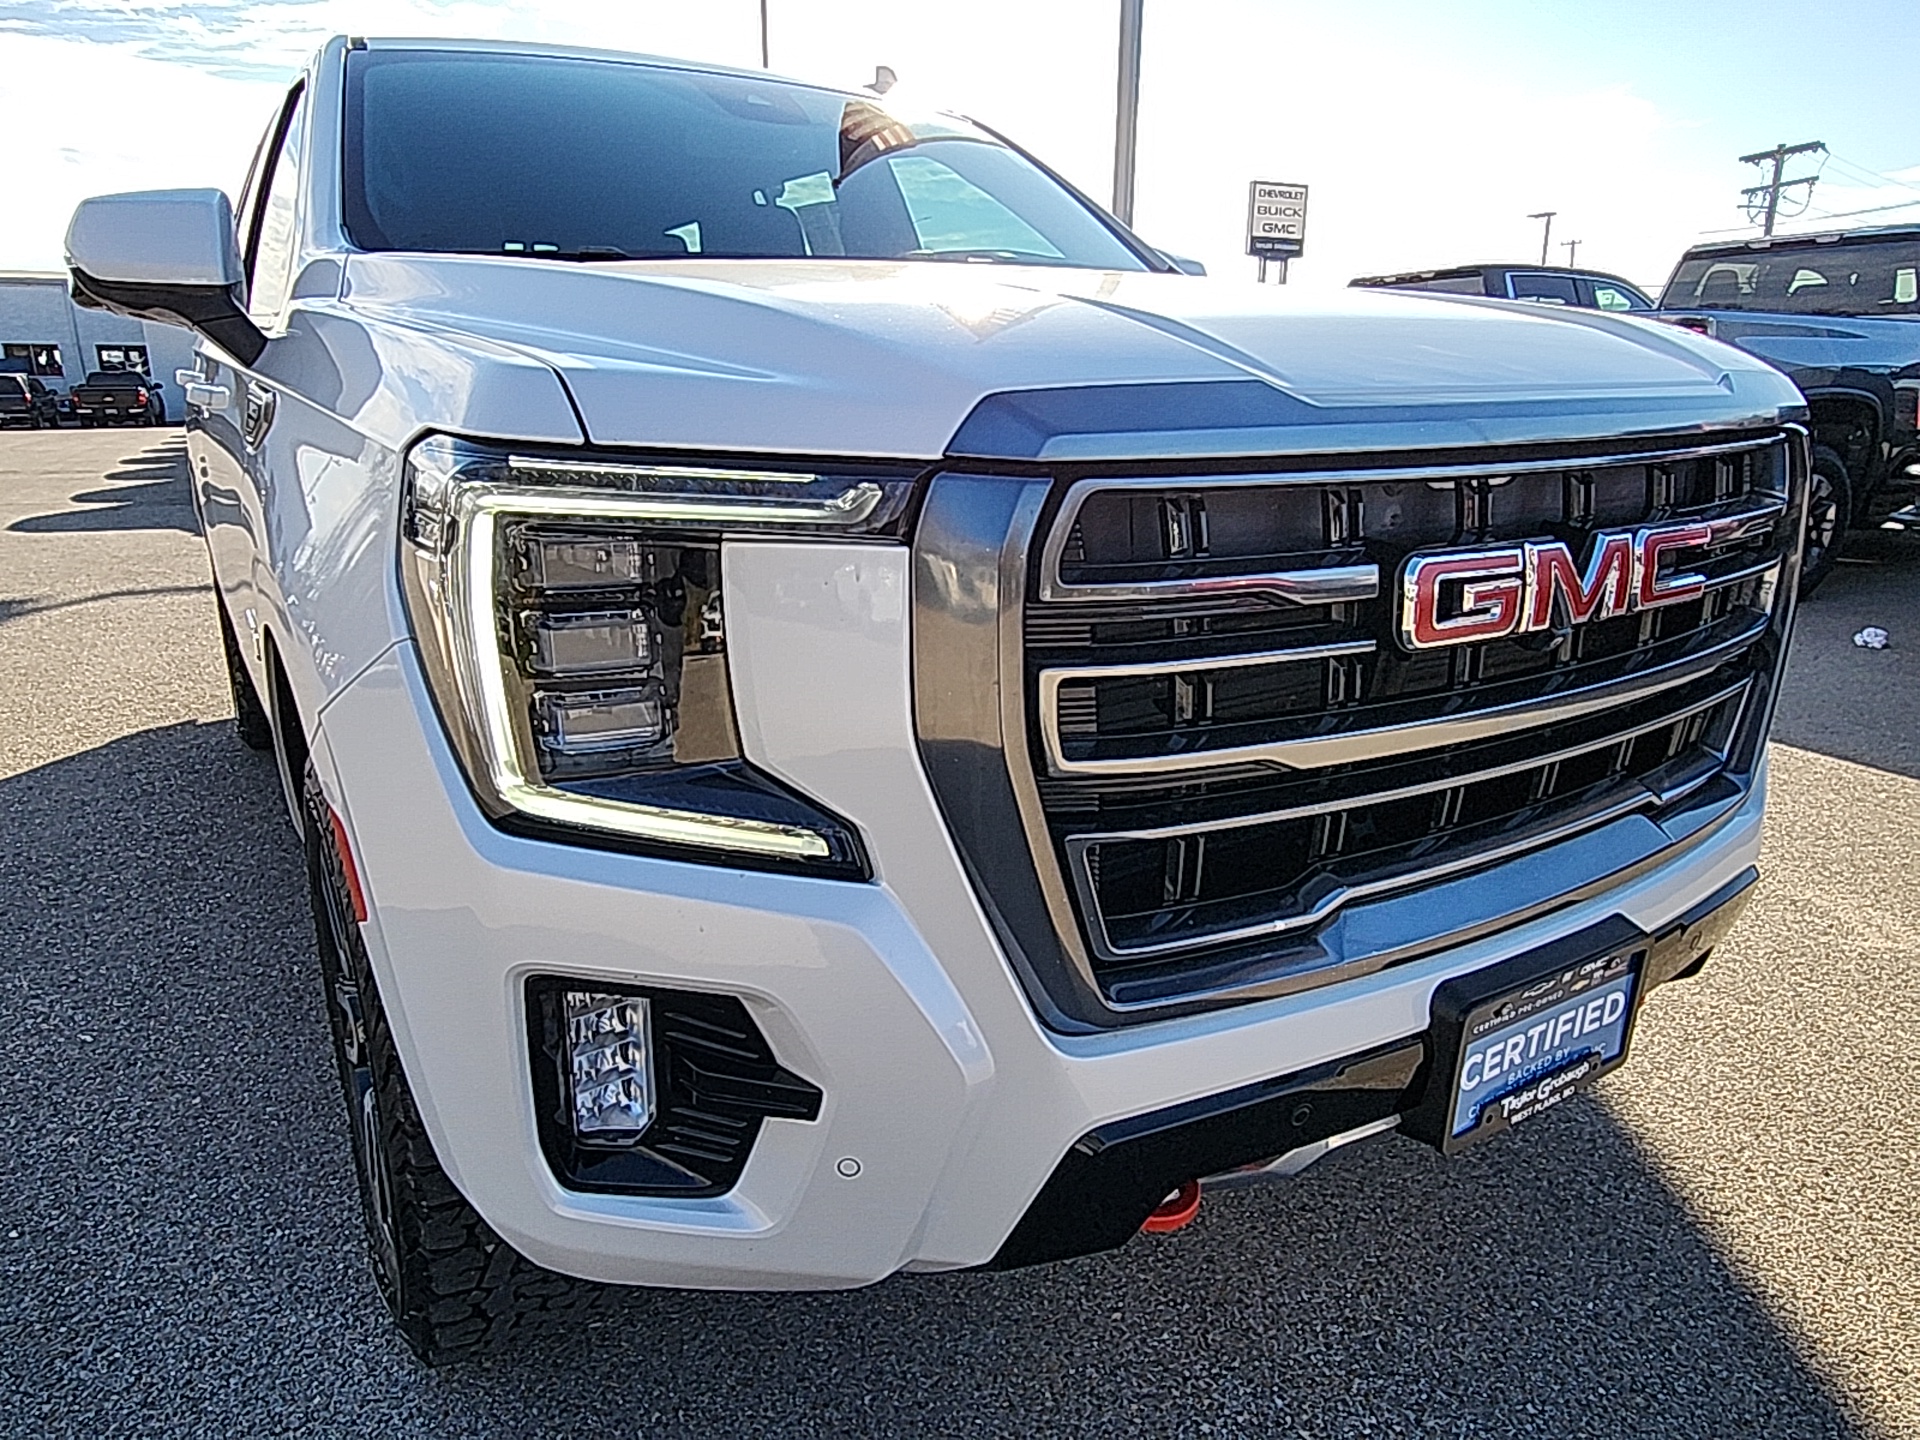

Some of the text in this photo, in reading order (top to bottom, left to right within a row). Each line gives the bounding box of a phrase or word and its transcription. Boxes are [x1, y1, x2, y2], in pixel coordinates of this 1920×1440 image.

[1258, 188, 1304, 200] CHEVROLET
[1257, 205, 1303, 218] BUICK
[1262, 222, 1297, 235] GMC
[1402, 528, 1711, 650] GMC
[1472, 1010, 1516, 1034] CERTIFIED
[1460, 990, 1626, 1092] CERTIFIED
[1508, 1055, 1552, 1085] BACKED
[1555, 1045, 1571, 1062] BY
[1501, 1089, 1537, 1118] Taylor
[1510, 1106, 1533, 1125] WEST
